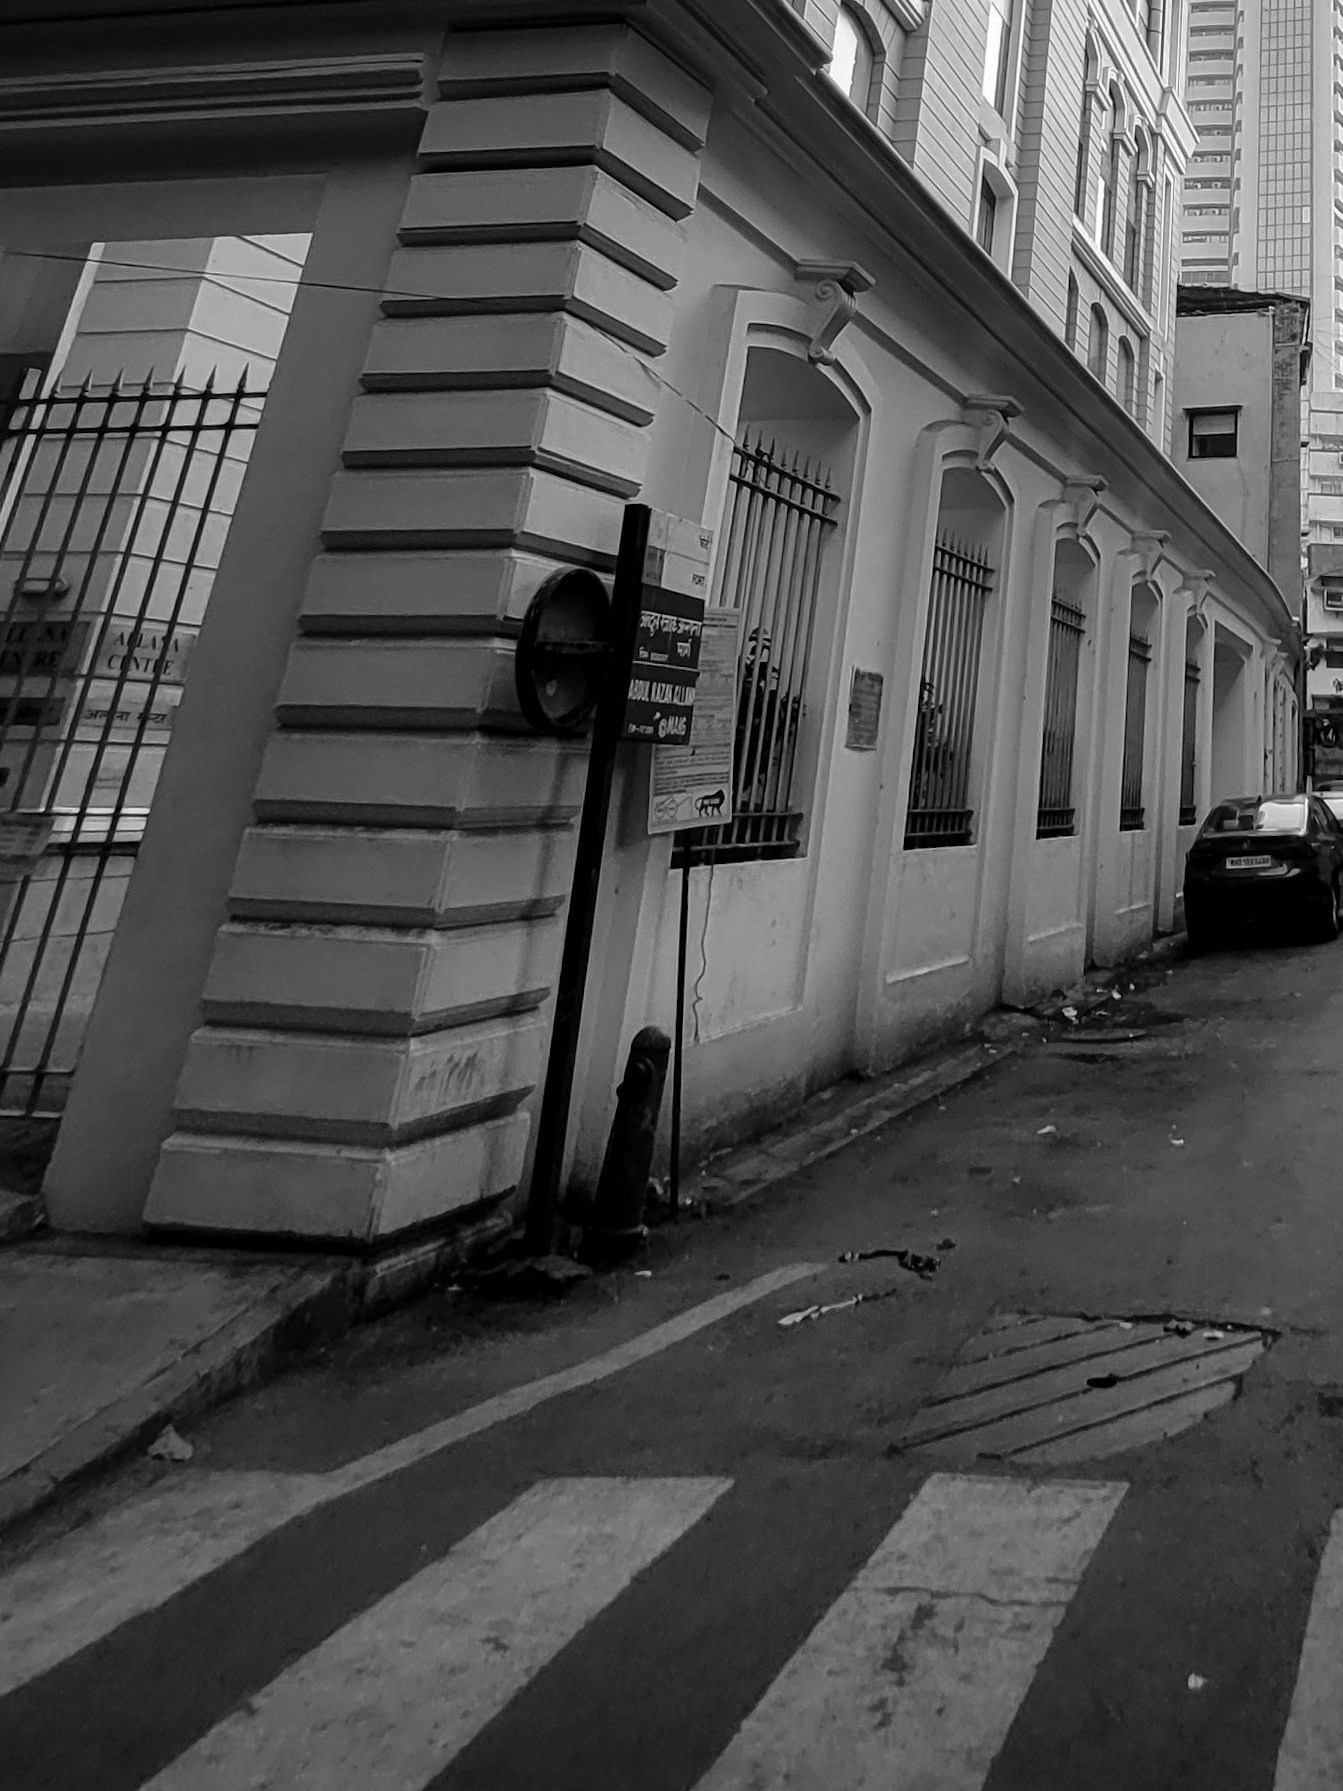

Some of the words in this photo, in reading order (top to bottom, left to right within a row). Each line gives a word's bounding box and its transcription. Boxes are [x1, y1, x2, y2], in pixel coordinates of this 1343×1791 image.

[692, 573, 706, 586] FORT
[113, 631, 179, 652] ALAA
[677, 638, 693, 658] मार्ग
[107, 654, 175, 675] CNTE
[627, 679, 650, 702] ABDUL
